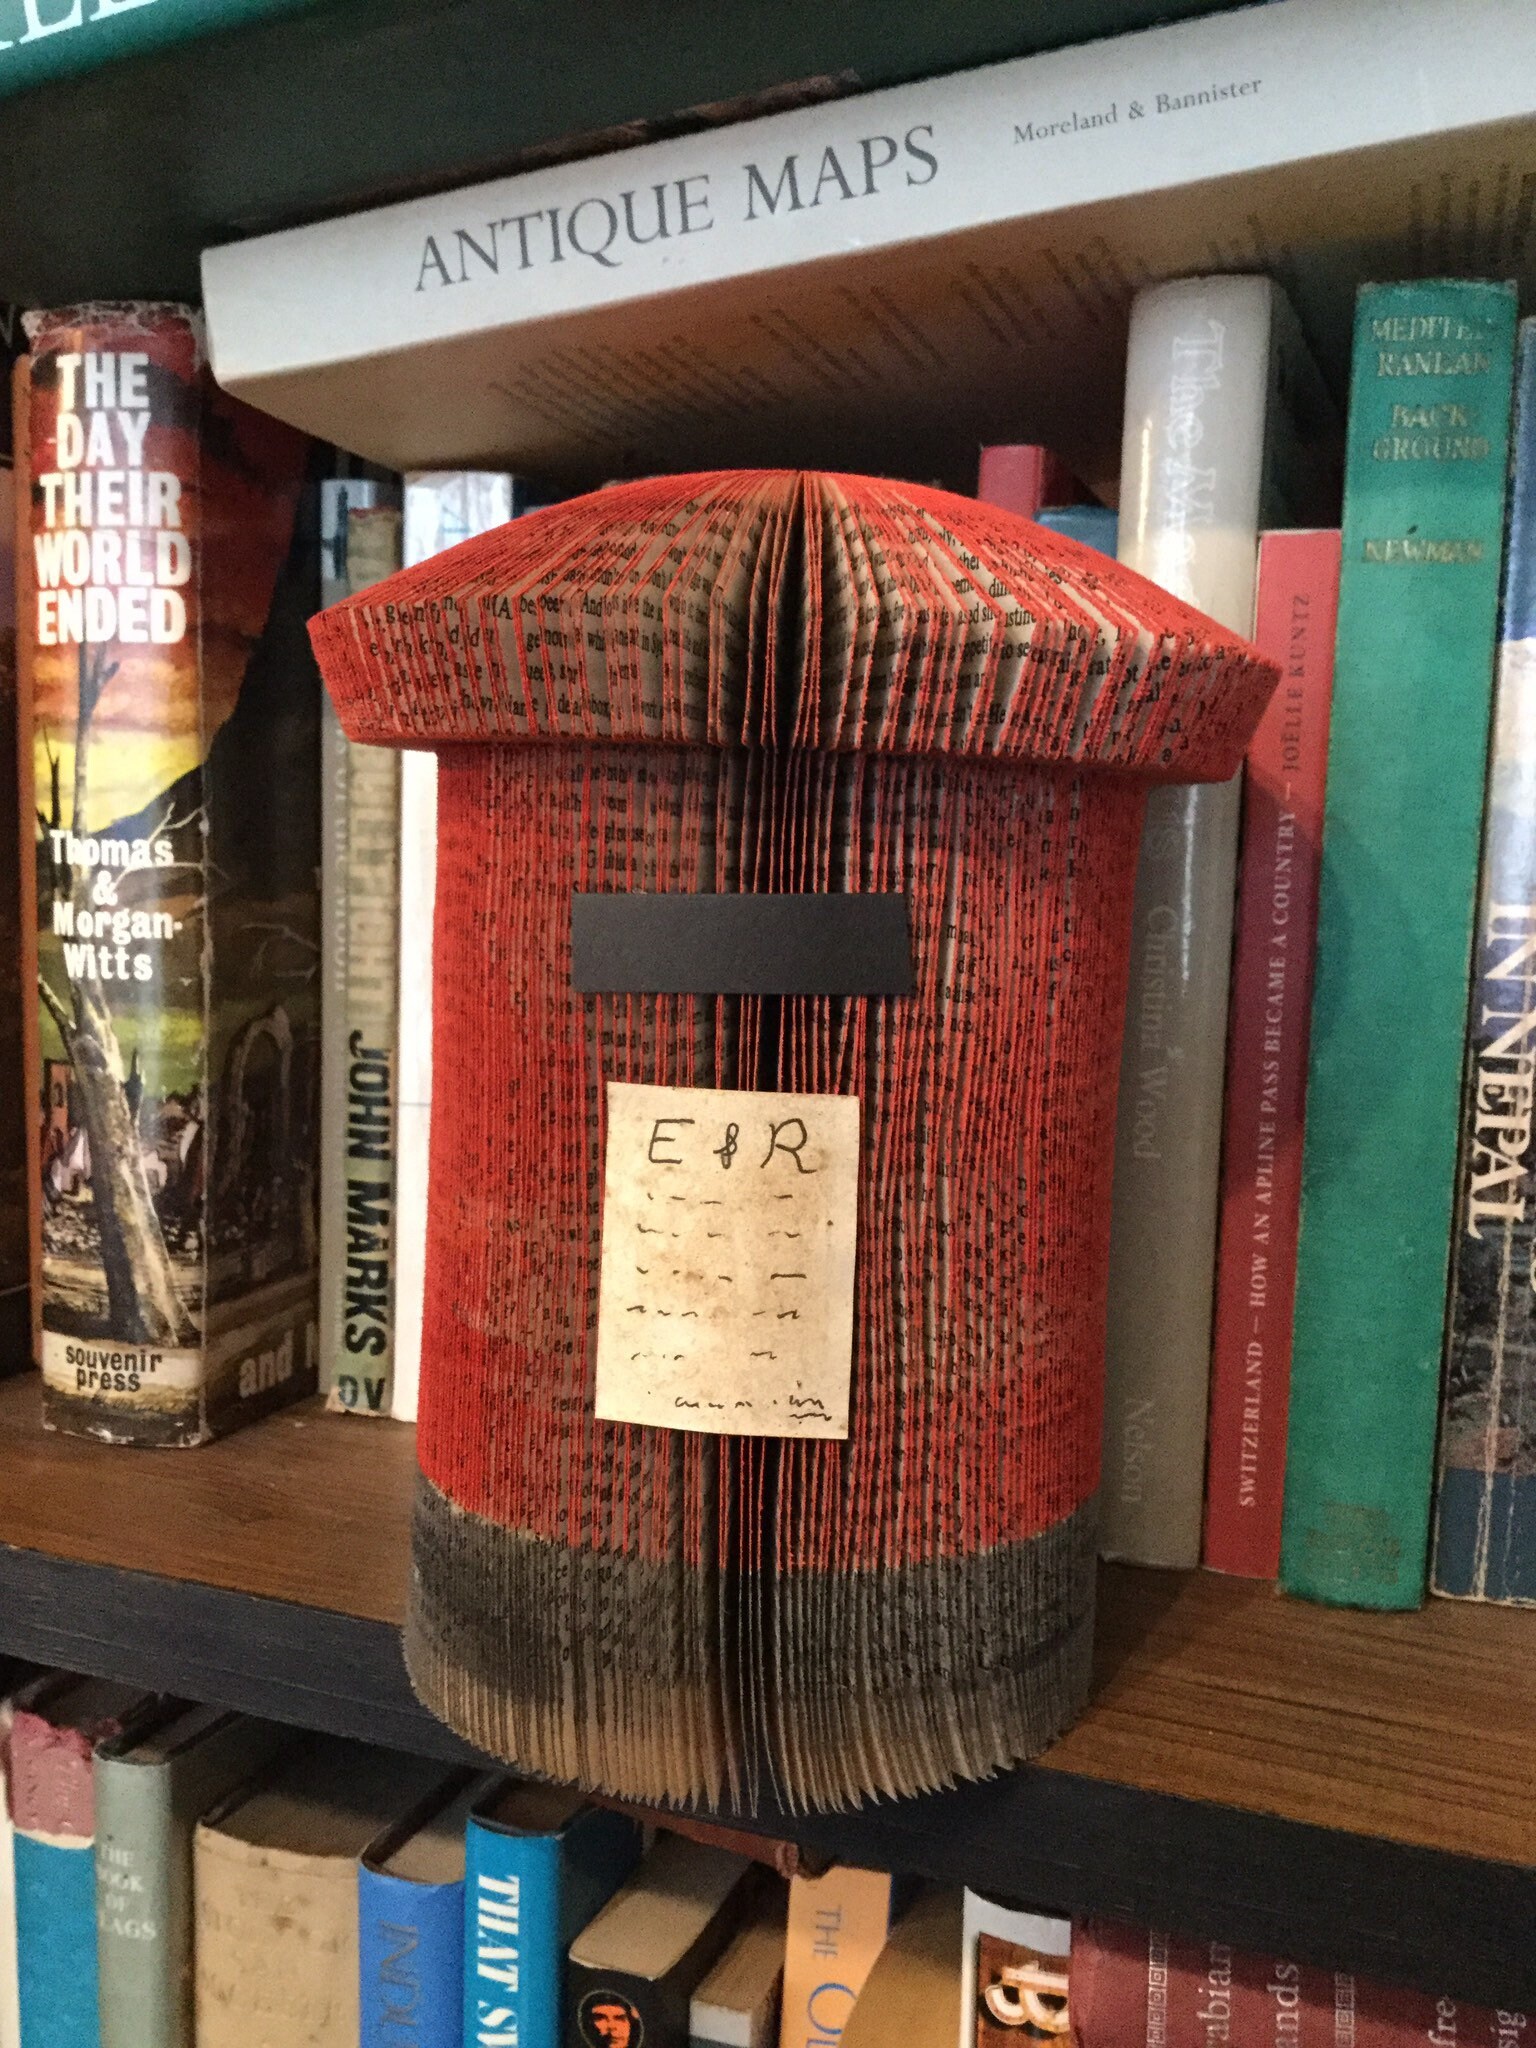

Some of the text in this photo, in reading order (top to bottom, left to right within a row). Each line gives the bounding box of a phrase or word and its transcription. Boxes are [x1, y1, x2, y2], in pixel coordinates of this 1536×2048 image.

[1013, 76, 1263, 145] Moreland & Bannister
[414, 124, 940, 292] ANTIQUE MAPS
[56, 352, 150, 409] THE
[56, 411, 150, 470] DAY
[39, 471, 181, 529] THEIR
[34, 529, 192, 588] WORLD
[38, 588, 186, 646] ENDED
[1286, 593, 1310, 679] KUNTZ
[50, 828, 175, 868] Thomas
[1271, 810, 1296, 925] COUNTRY
[92, 871, 118, 908] &
[53, 907, 183, 946] Morgan-
[1272, 933, 1288, 948] A
[63, 943, 154, 982] Witts
[1138, 904, 1179, 1050] Christina
[1264, 956, 1286, 1053] BECAME
[348, 1030, 391, 1160] JOHN
[1132, 1064, 1168, 1161] Wood
[1260, 1061, 1280, 1113] PASS
[648, 1118, 695, 1164] E
[760, 1117, 818, 1174] R
[1467, 1003, 1536, 1240] NEPAL
[1255, 1120, 1277, 1206] APLINE
[1253, 1215, 1271, 1246] AN
[344, 1178, 393, 1355] MARKS
[1249, 1252, 1270, 1308] HOW
[65, 1346, 163, 1376] souvenir
[76, 1367, 142, 1394] press
[239, 1329, 294, 1399] and
[1121, 1397, 1157, 1503] Nelson
[1239, 1341, 1264, 1508] SWITZERLAND
[477, 1874, 520, 1992] THAT
[814, 1904, 843, 1961] THE
